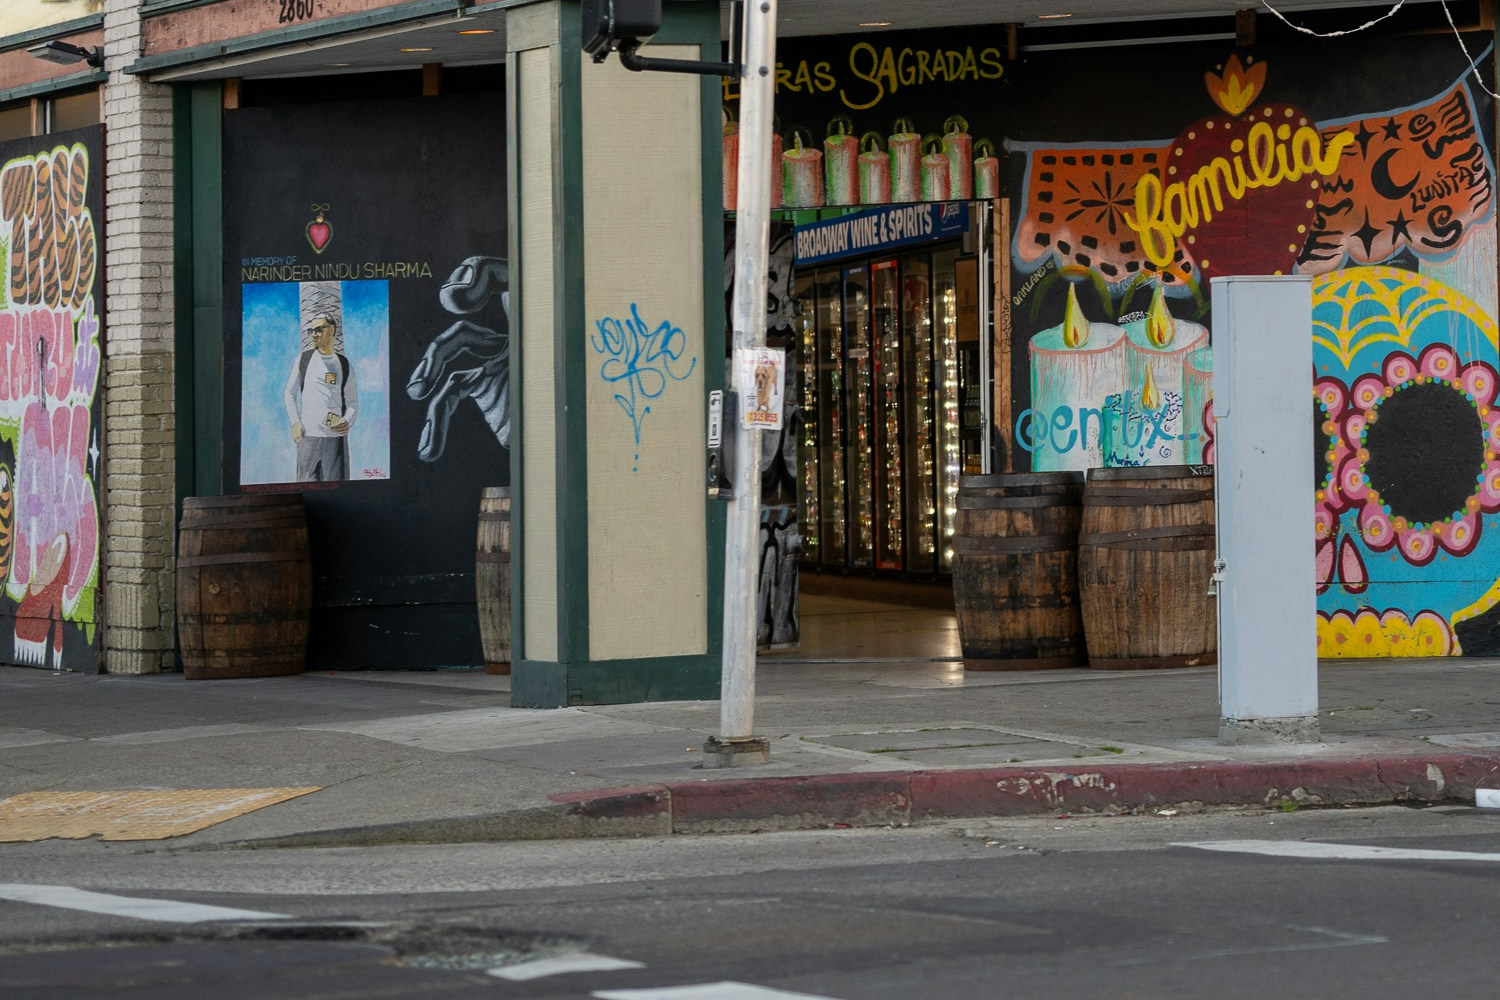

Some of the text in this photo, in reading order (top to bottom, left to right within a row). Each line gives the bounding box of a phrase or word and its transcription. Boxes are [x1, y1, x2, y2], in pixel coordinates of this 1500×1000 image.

[840, 42, 1004, 110] SAGRADAS
[1125, 121, 1356, 267] familia
[797, 203, 933, 260] BROADWAY WINE & SPIRITS
[241, 256, 297, 266] IN MEMORY OF
[242, 262, 432, 282] NARINDER NINDU SHARMA
